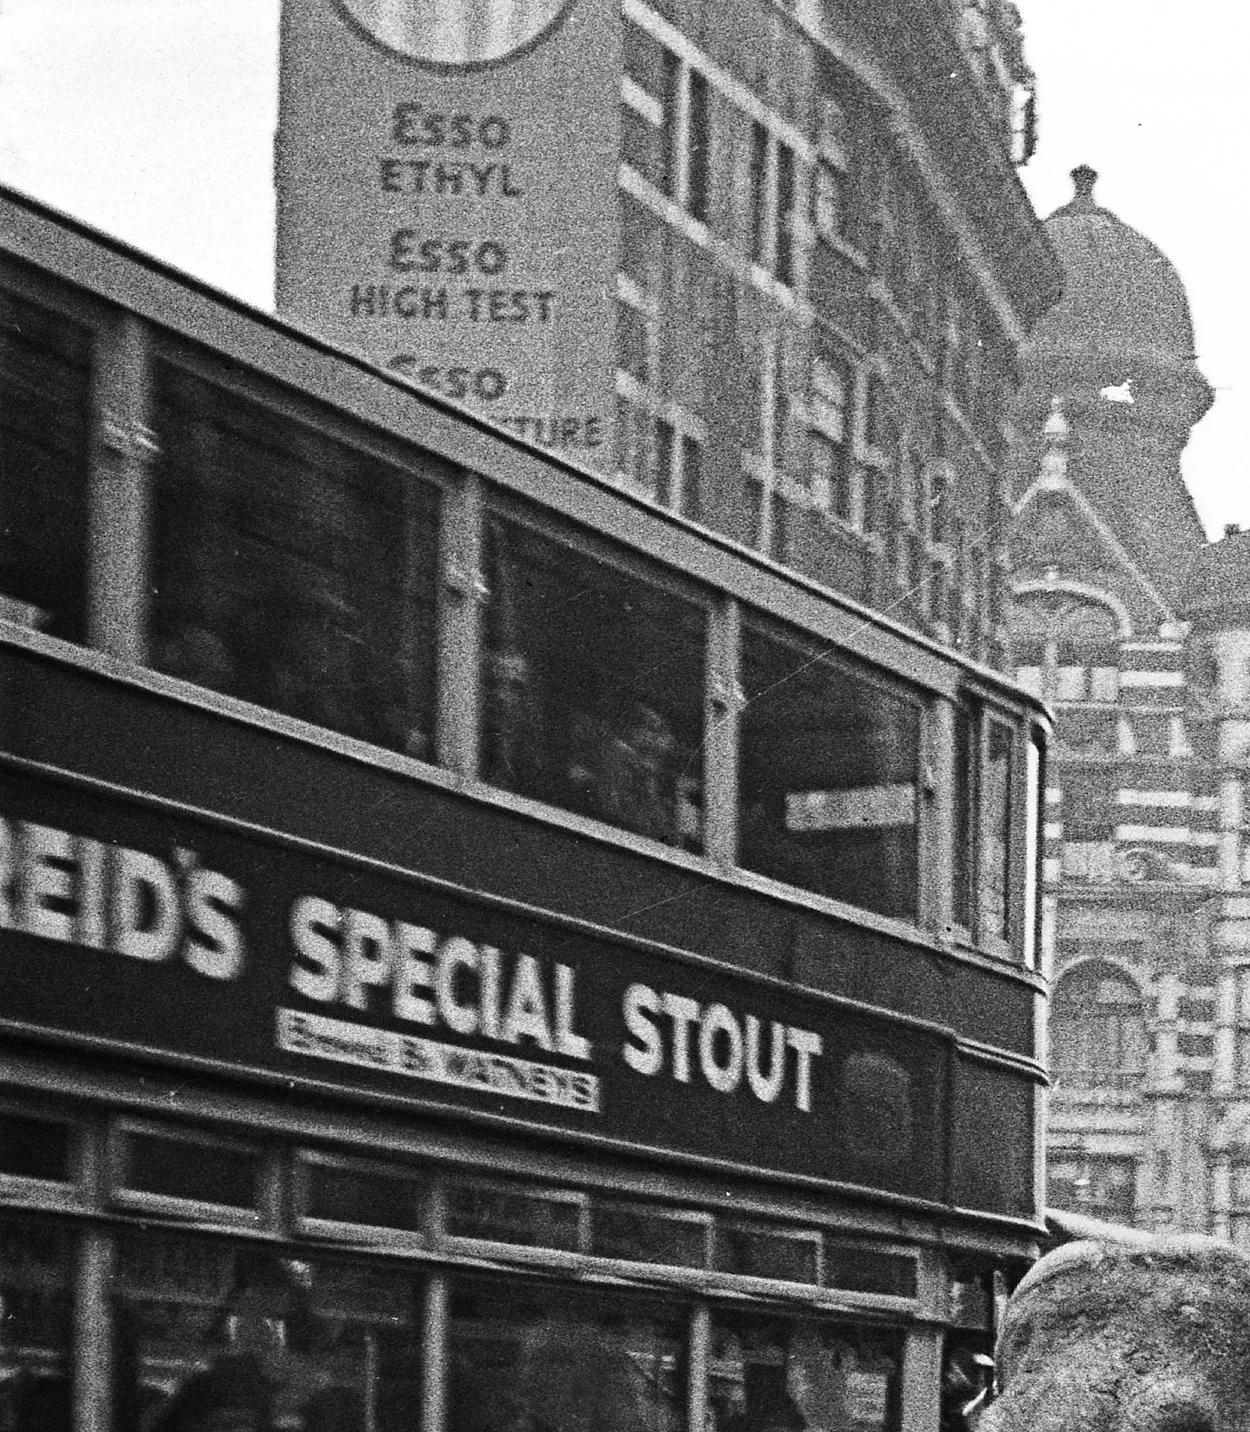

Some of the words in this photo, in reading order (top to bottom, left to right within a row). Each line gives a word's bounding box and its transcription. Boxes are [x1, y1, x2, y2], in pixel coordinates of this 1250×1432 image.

[379, 158, 522, 197] ETHYL
[350, 283, 448, 319] HIGH
[463, 288, 554, 322] TEST
[0, 816, 246, 981] EID'S
[289, 894, 593, 1061] SPECIAL
[622, 982, 824, 1113] STOUT
